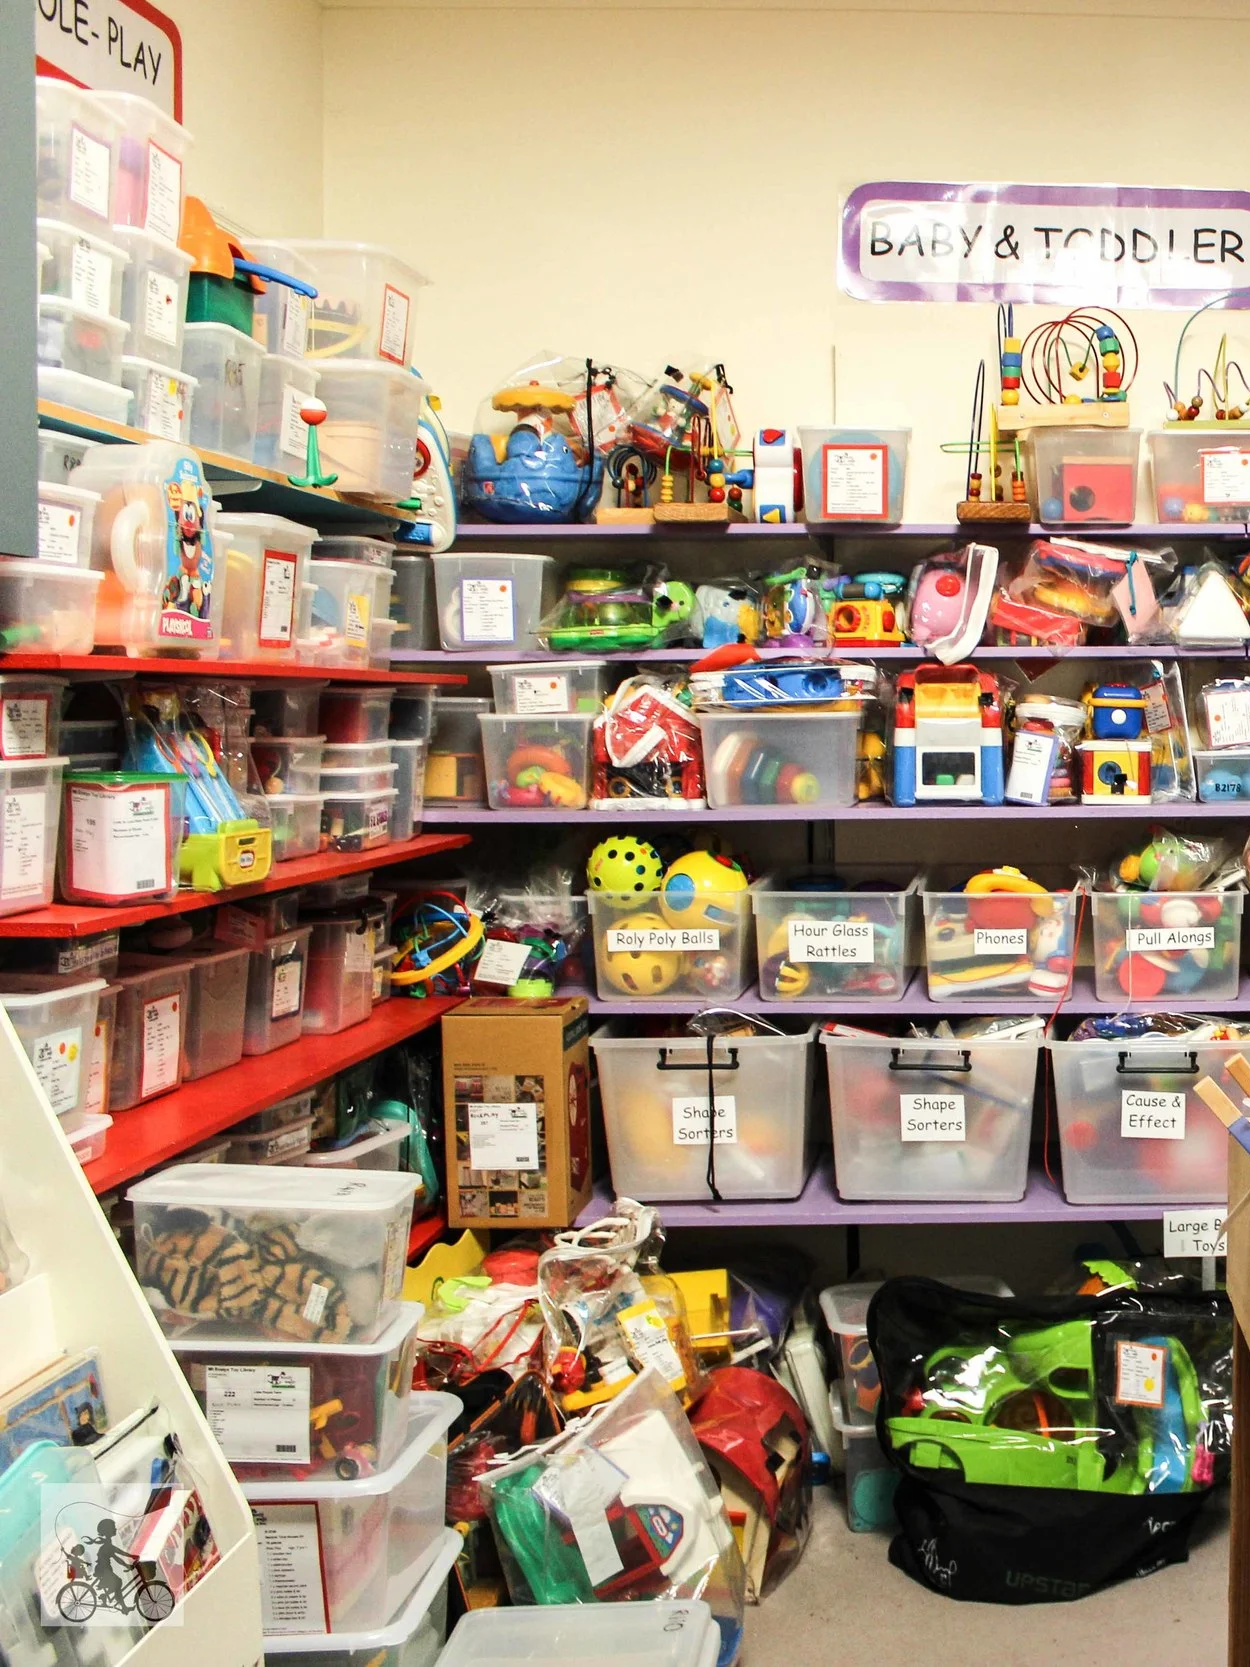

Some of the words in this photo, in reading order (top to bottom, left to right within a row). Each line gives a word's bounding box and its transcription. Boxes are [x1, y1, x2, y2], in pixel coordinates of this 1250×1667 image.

[108, 16, 162, 85] PLAY
[870, 221, 983, 259] BABY
[994, 225, 1020, 260] &
[1215, 783, 1241, 792] B2178
[793, 924, 828, 937] Hour
[832, 924, 869, 937] Glass
[616, 932, 645, 948] Roly
[649, 932, 676, 948] Poly
[682, 931, 714, 945] Balls
[976, 932, 1024, 944] Phones
[1137, 932, 1161, 945] Pull
[1167, 931, 1212, 946] Alongs
[806, 945, 857, 957] Rattles
[912, 1098, 956, 1113] Shape
[1126, 1094, 1167, 1108] Cause
[1171, 1096, 1182, 1108] &
[907, 1118, 963, 1131] Sorters
[1128, 1114, 1177, 1129] Effect
[1169, 1220, 1209, 1235] Large
[1192, 1239, 1225, 1253] Toys
